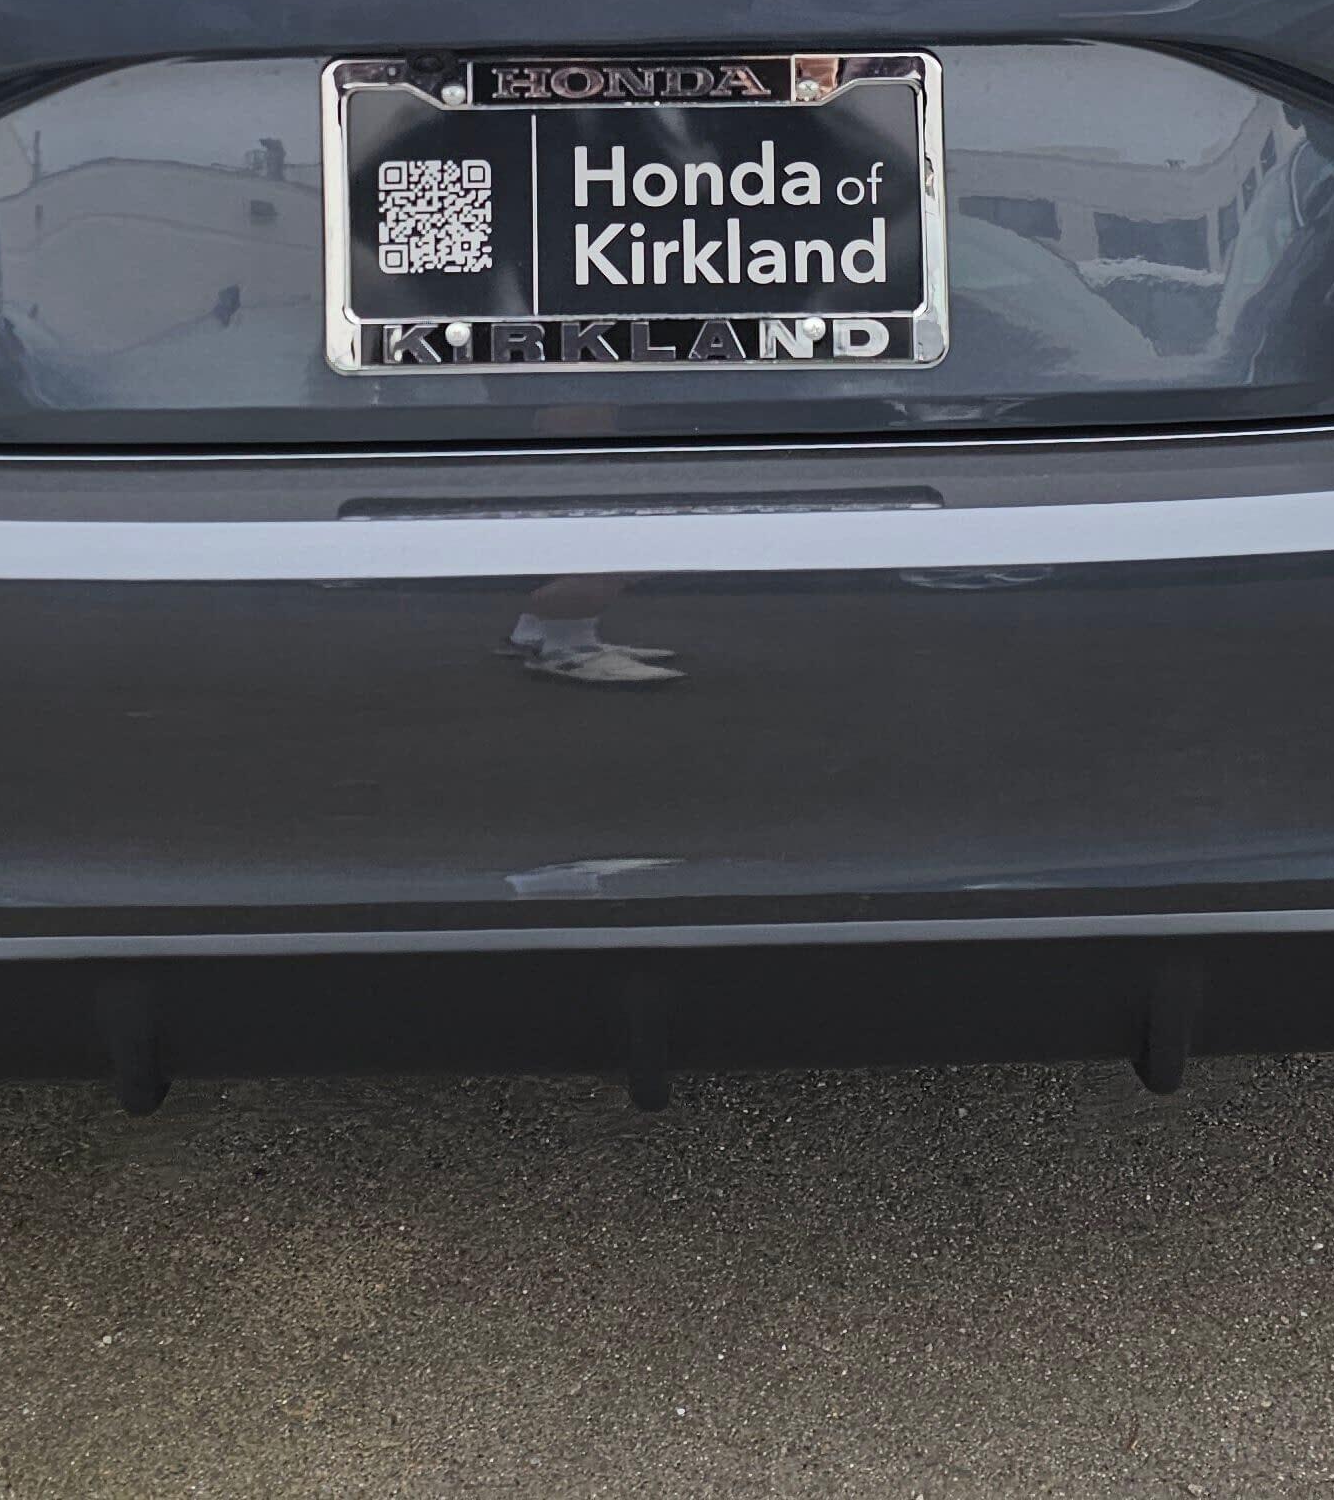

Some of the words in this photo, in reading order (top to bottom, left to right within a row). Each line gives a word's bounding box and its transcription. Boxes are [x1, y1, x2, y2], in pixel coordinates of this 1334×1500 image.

[491, 65, 772, 99] HONDA
[574, 140, 822, 207] Honda
[836, 161, 884, 206] of
[575, 217, 887, 286] Kirkland
